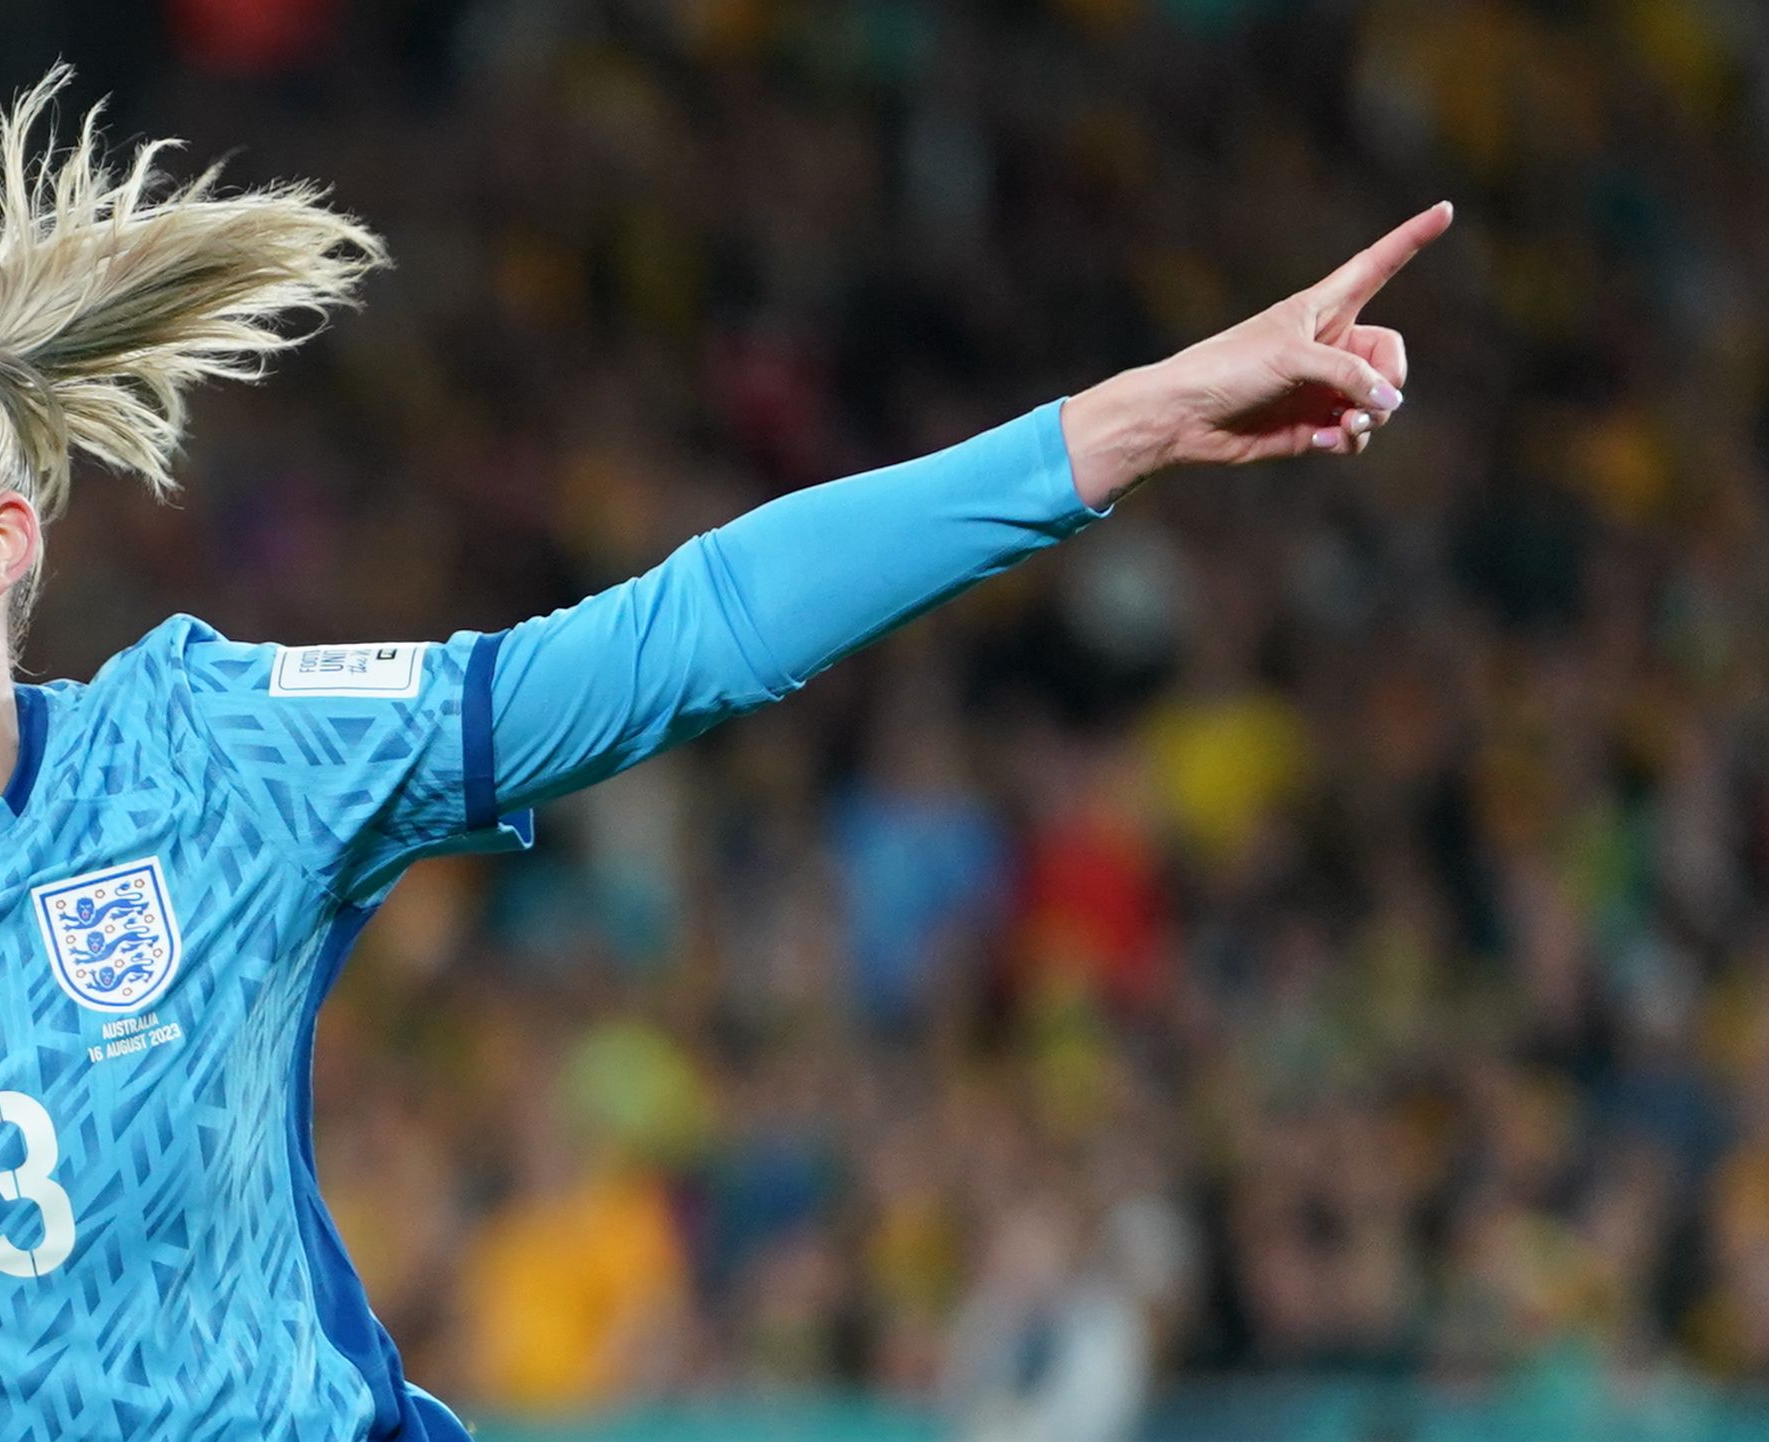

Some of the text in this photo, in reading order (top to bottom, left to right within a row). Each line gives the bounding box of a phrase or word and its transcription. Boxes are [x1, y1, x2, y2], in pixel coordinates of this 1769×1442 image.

[103, 1013, 158, 1038] AUSTRALIA
[89, 1023, 181, 1062] 16 AUGUST 2023
